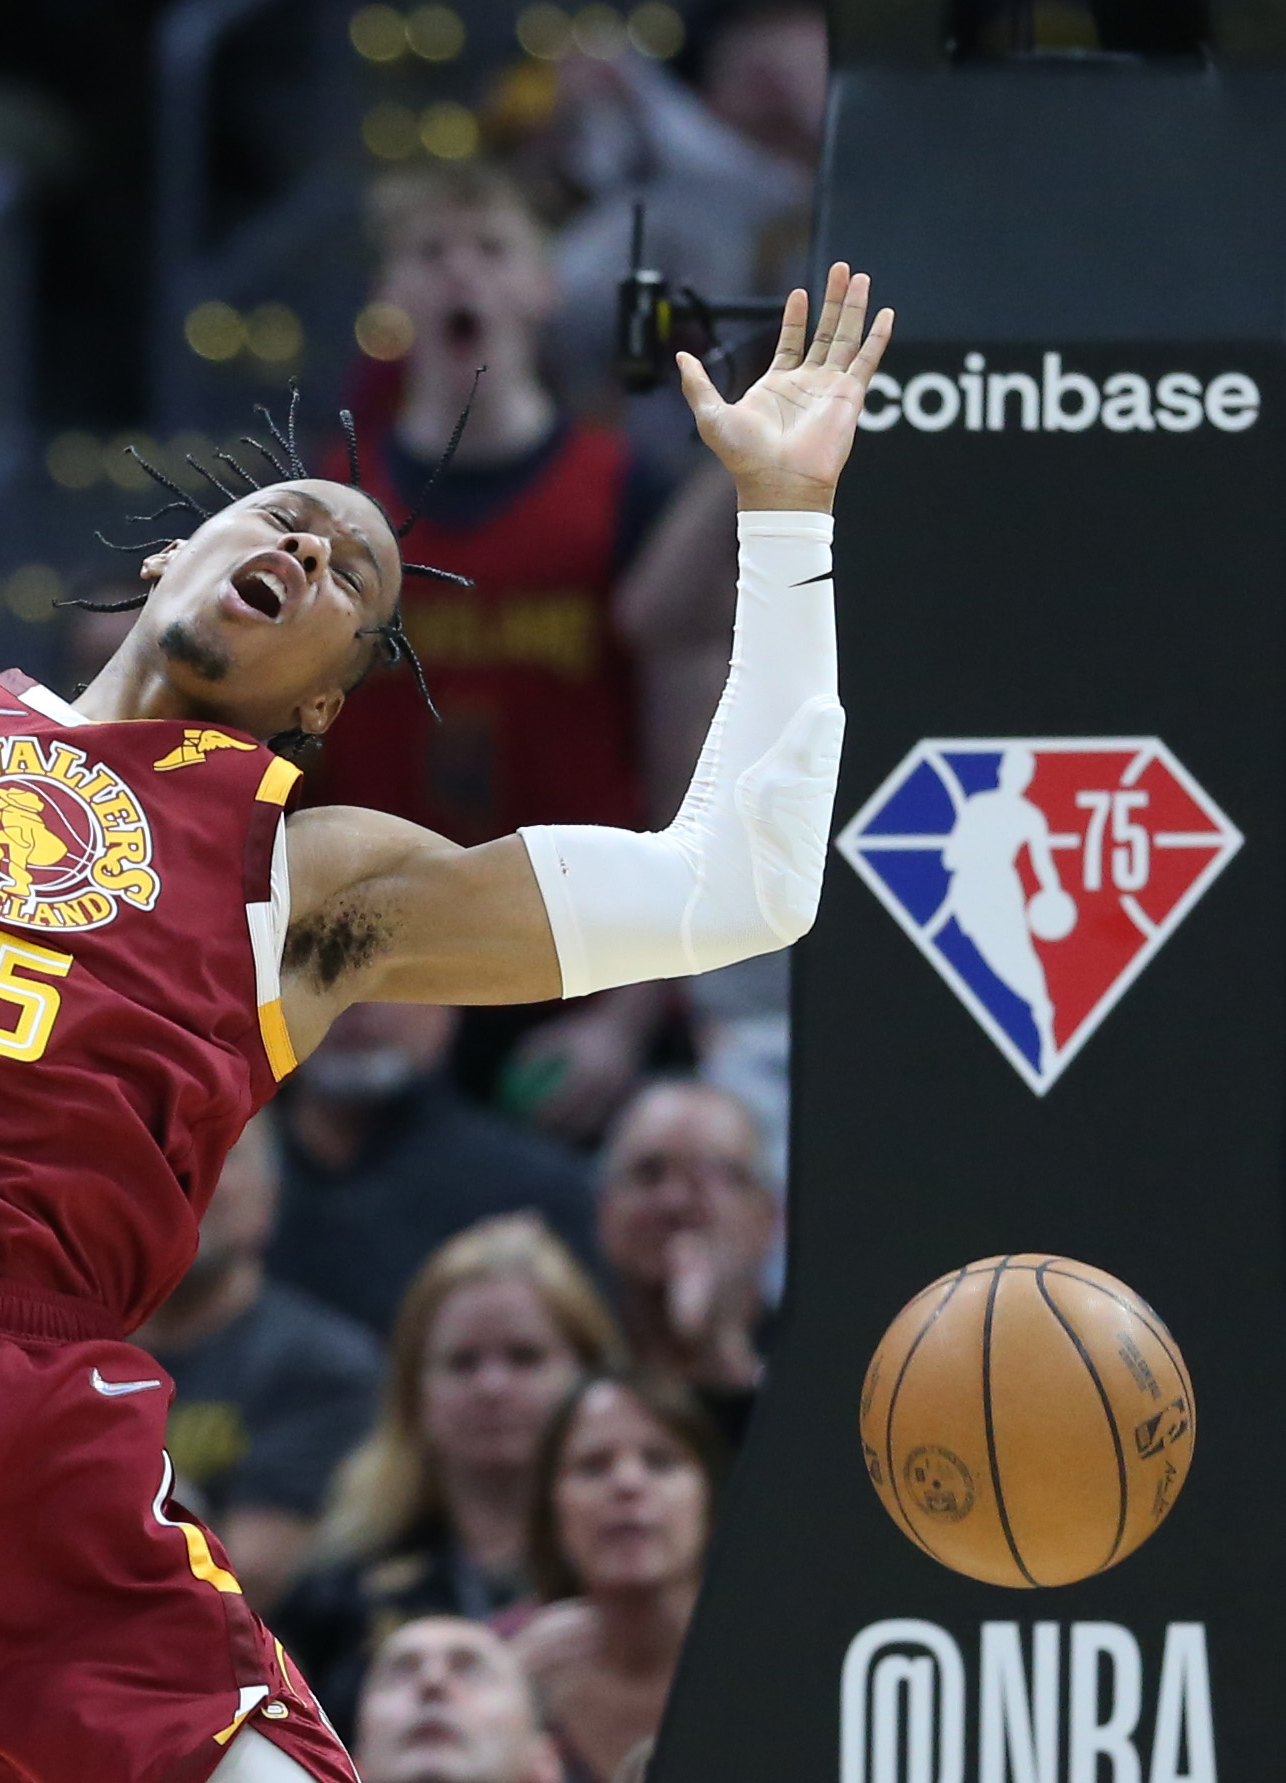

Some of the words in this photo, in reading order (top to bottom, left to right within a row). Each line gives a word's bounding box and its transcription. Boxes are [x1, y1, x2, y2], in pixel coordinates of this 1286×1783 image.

[857, 351, 1261, 433] coinbase
[1075, 790, 1150, 891] 75
[839, 1617, 1218, 1783] @NBA
